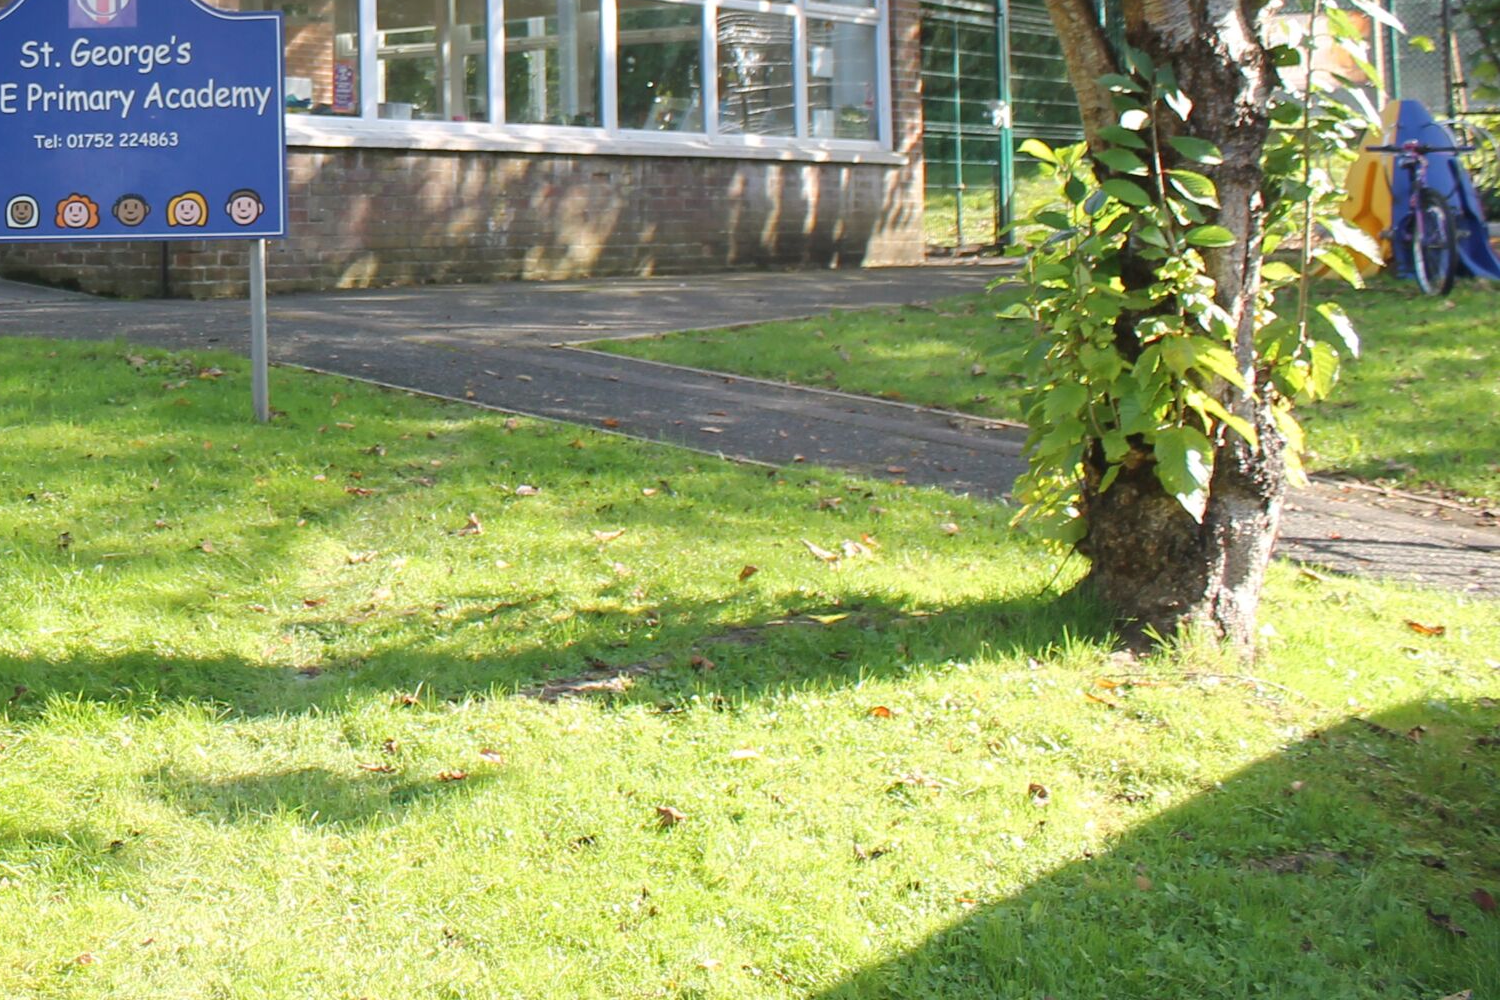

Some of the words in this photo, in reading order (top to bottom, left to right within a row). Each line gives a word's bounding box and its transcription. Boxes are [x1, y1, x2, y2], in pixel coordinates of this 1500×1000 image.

[19, 40, 61, 68] St.
[70, 35, 191, 74] George's
[0, 83, 18, 113] E
[27, 83, 135, 119] Primary
[143, 78, 271, 116] Academy
[33, 134, 62, 149] Tel:
[66, 133, 114, 148] 01752
[119, 132, 179, 148] 224863
